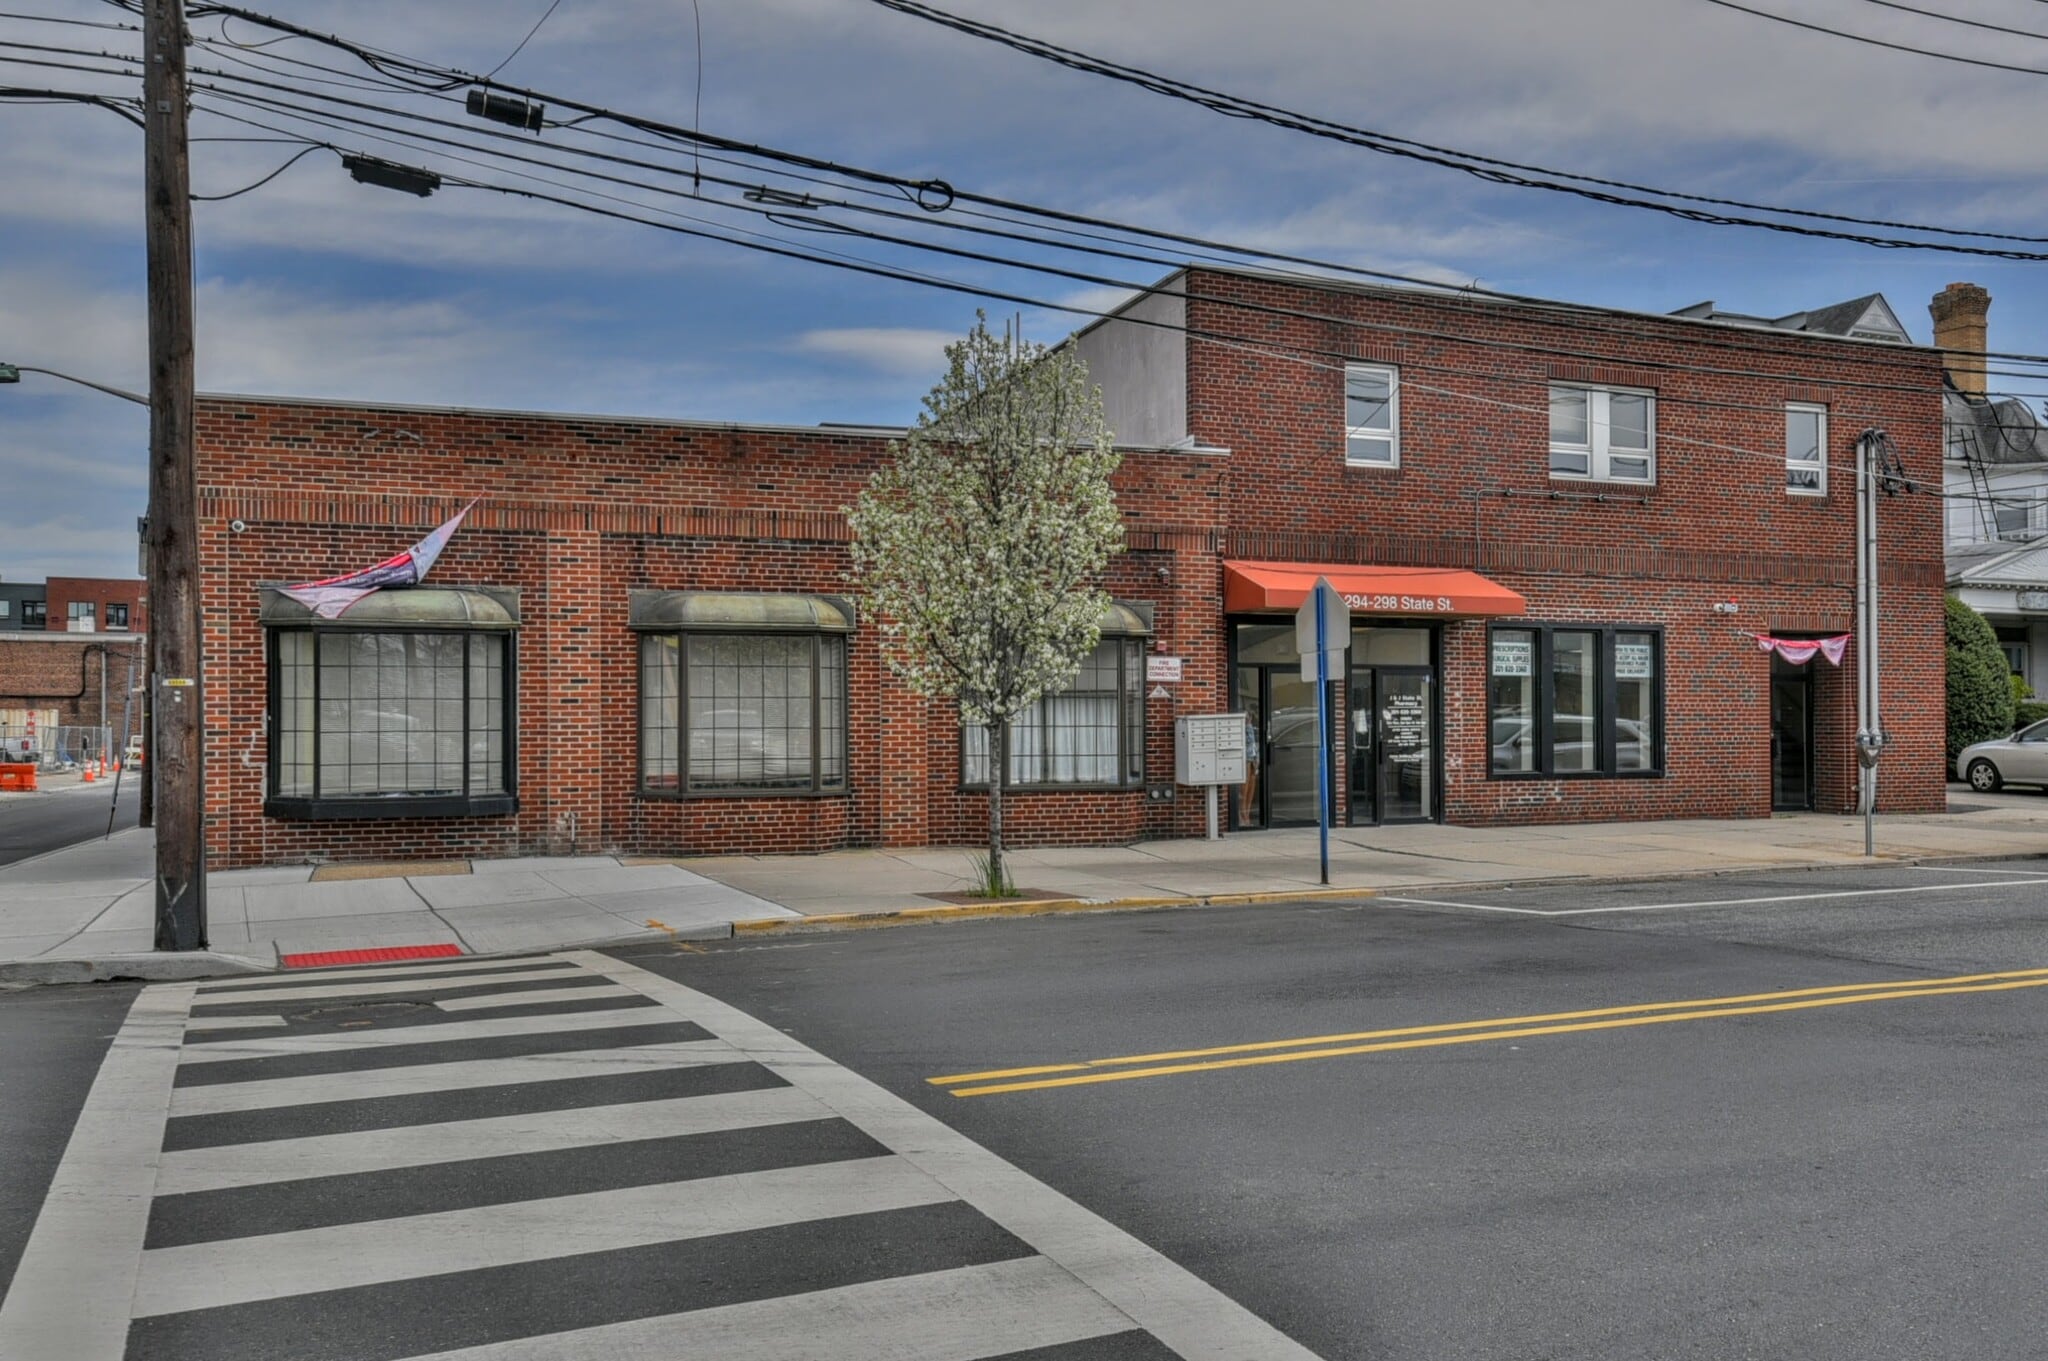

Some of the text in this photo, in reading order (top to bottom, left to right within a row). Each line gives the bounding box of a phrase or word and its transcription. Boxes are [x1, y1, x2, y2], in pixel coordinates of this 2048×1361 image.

[1344, 594, 1455, 611] 294-298 State St.
[1493, 645, 1529, 653] PRESCRIPTIONS
